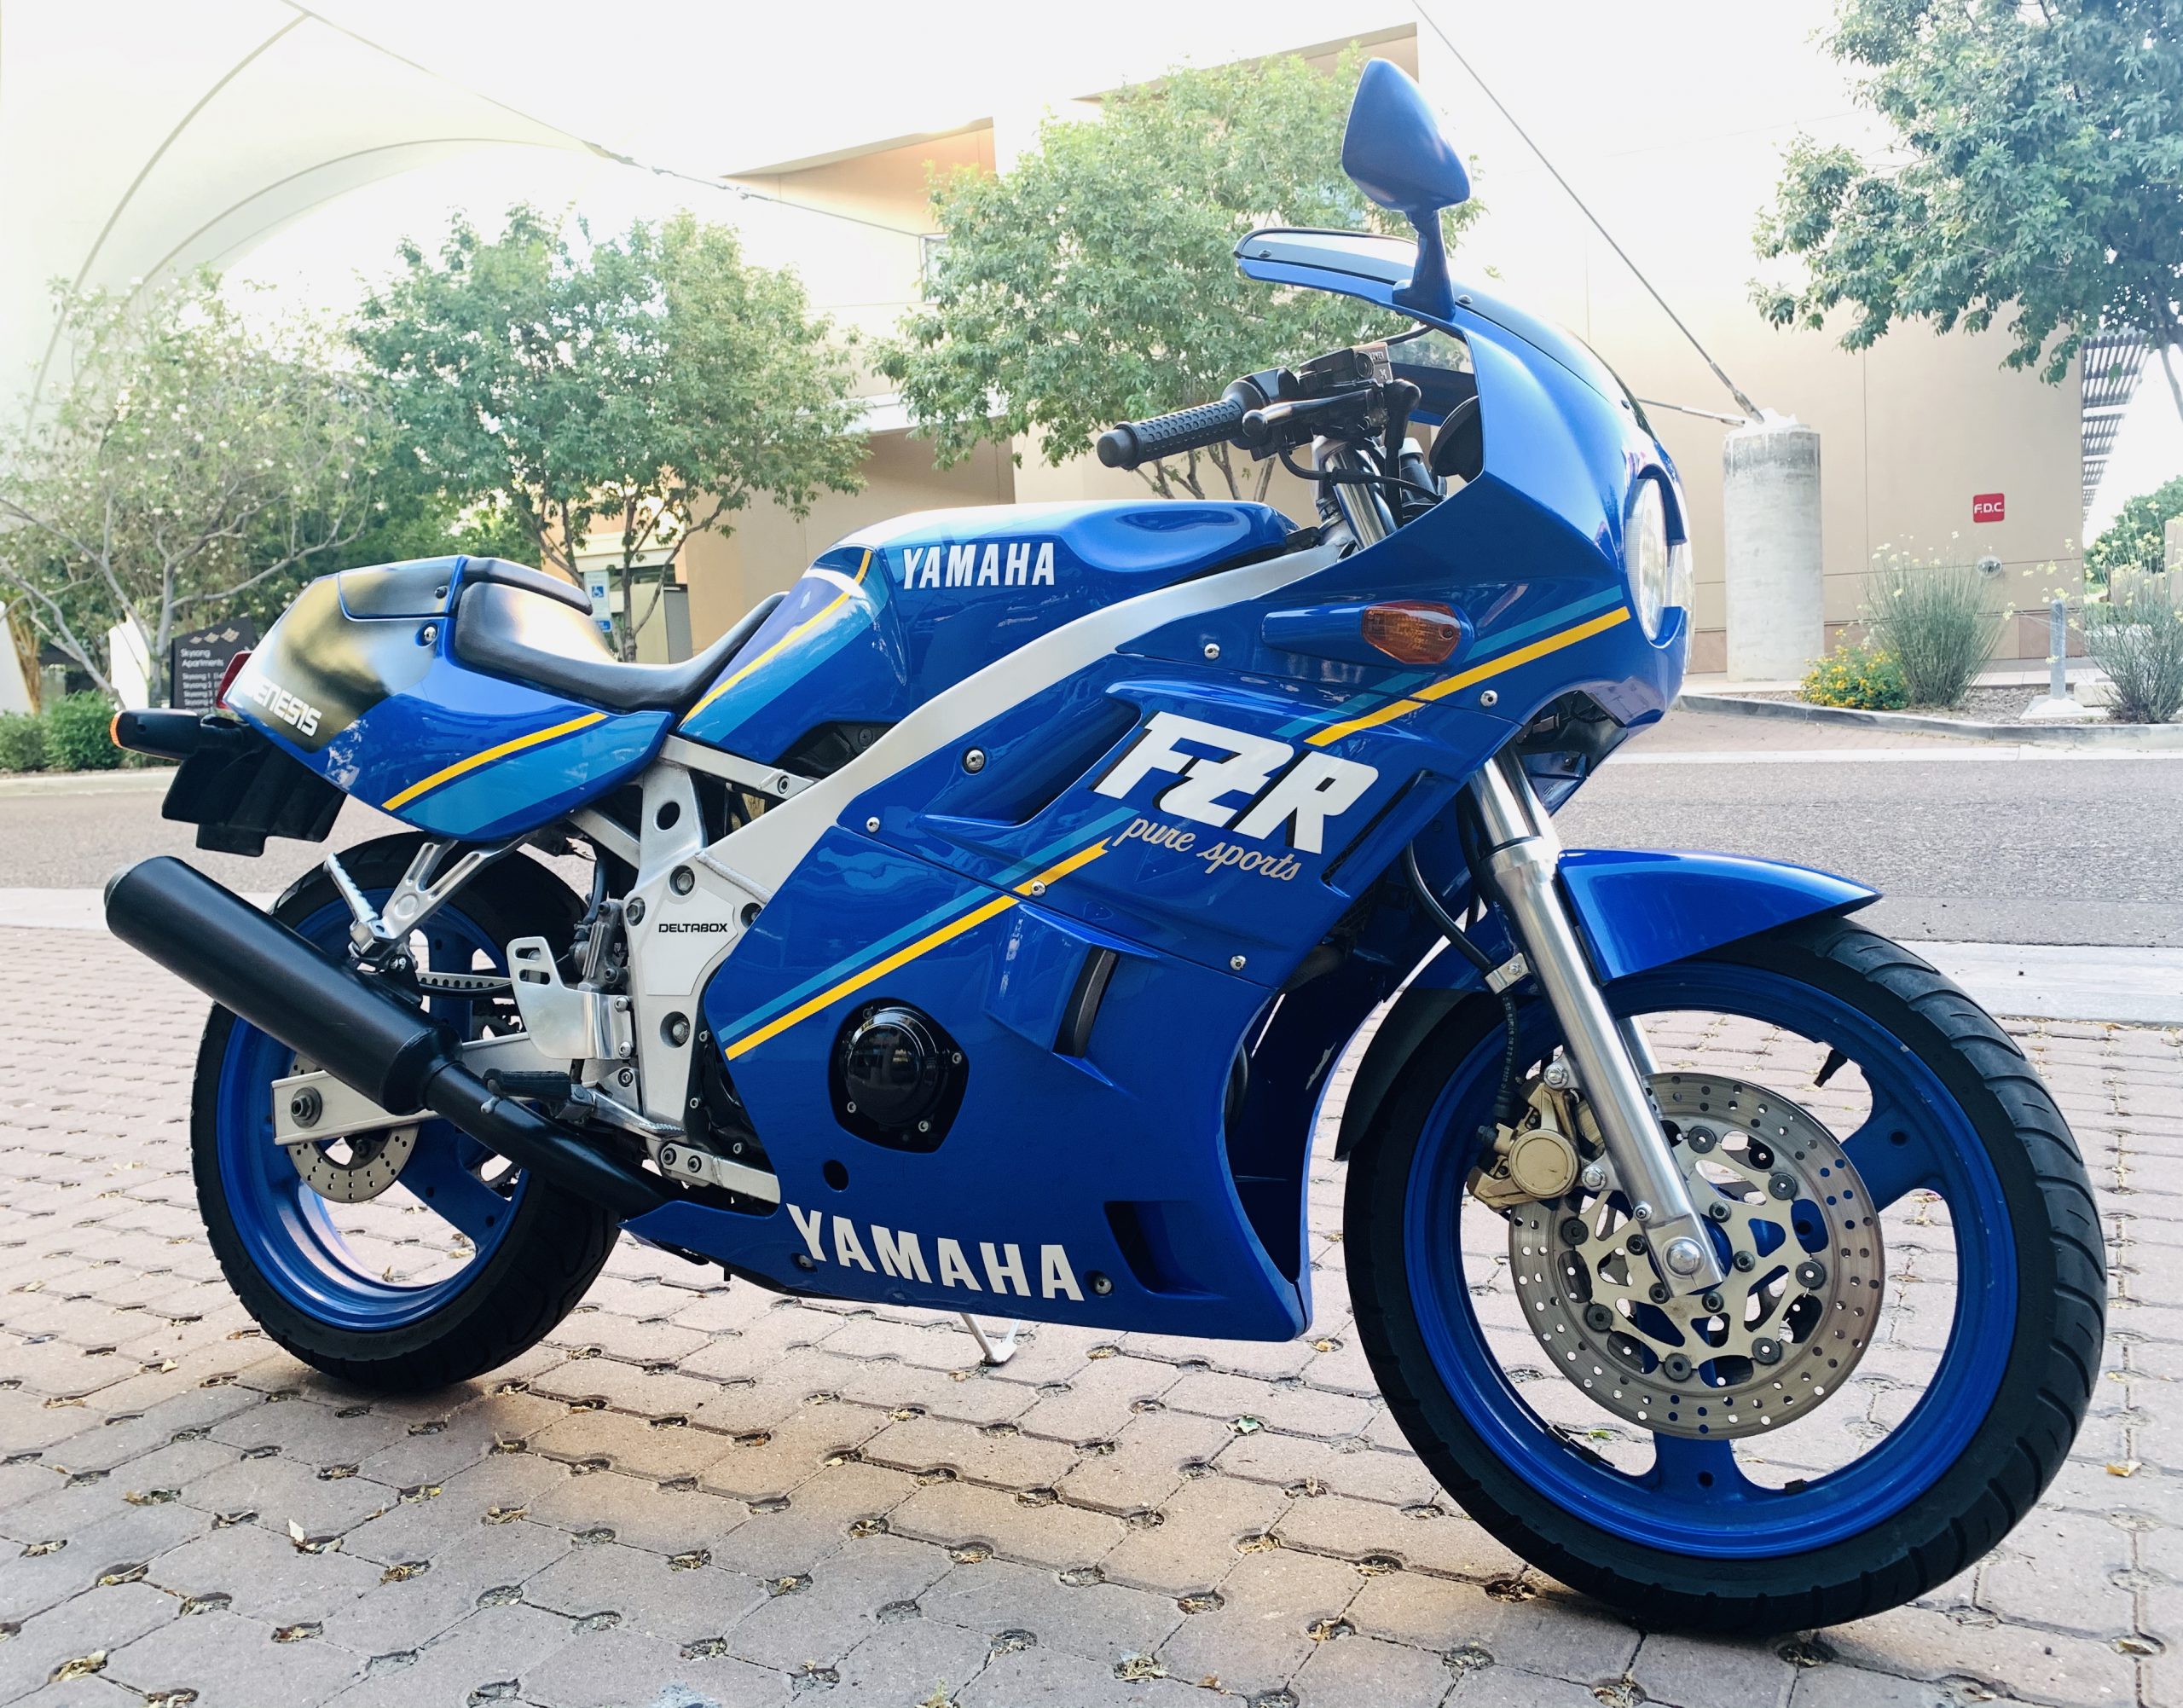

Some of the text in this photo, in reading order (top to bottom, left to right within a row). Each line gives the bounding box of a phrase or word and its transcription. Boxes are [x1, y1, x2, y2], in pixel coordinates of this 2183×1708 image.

[1974, 501, 2004, 514] F.D.C.
[903, 542, 1055, 589] YAMAHA
[181, 648, 211, 658] Skysong
[182, 659, 224, 668] Apartments
[1090, 710, 1379, 854] FZR
[1112, 818, 1302, 882] pure sports
[658, 923, 727, 933] DELTABOX
[786, 1203, 1085, 1301] YAMAHA
